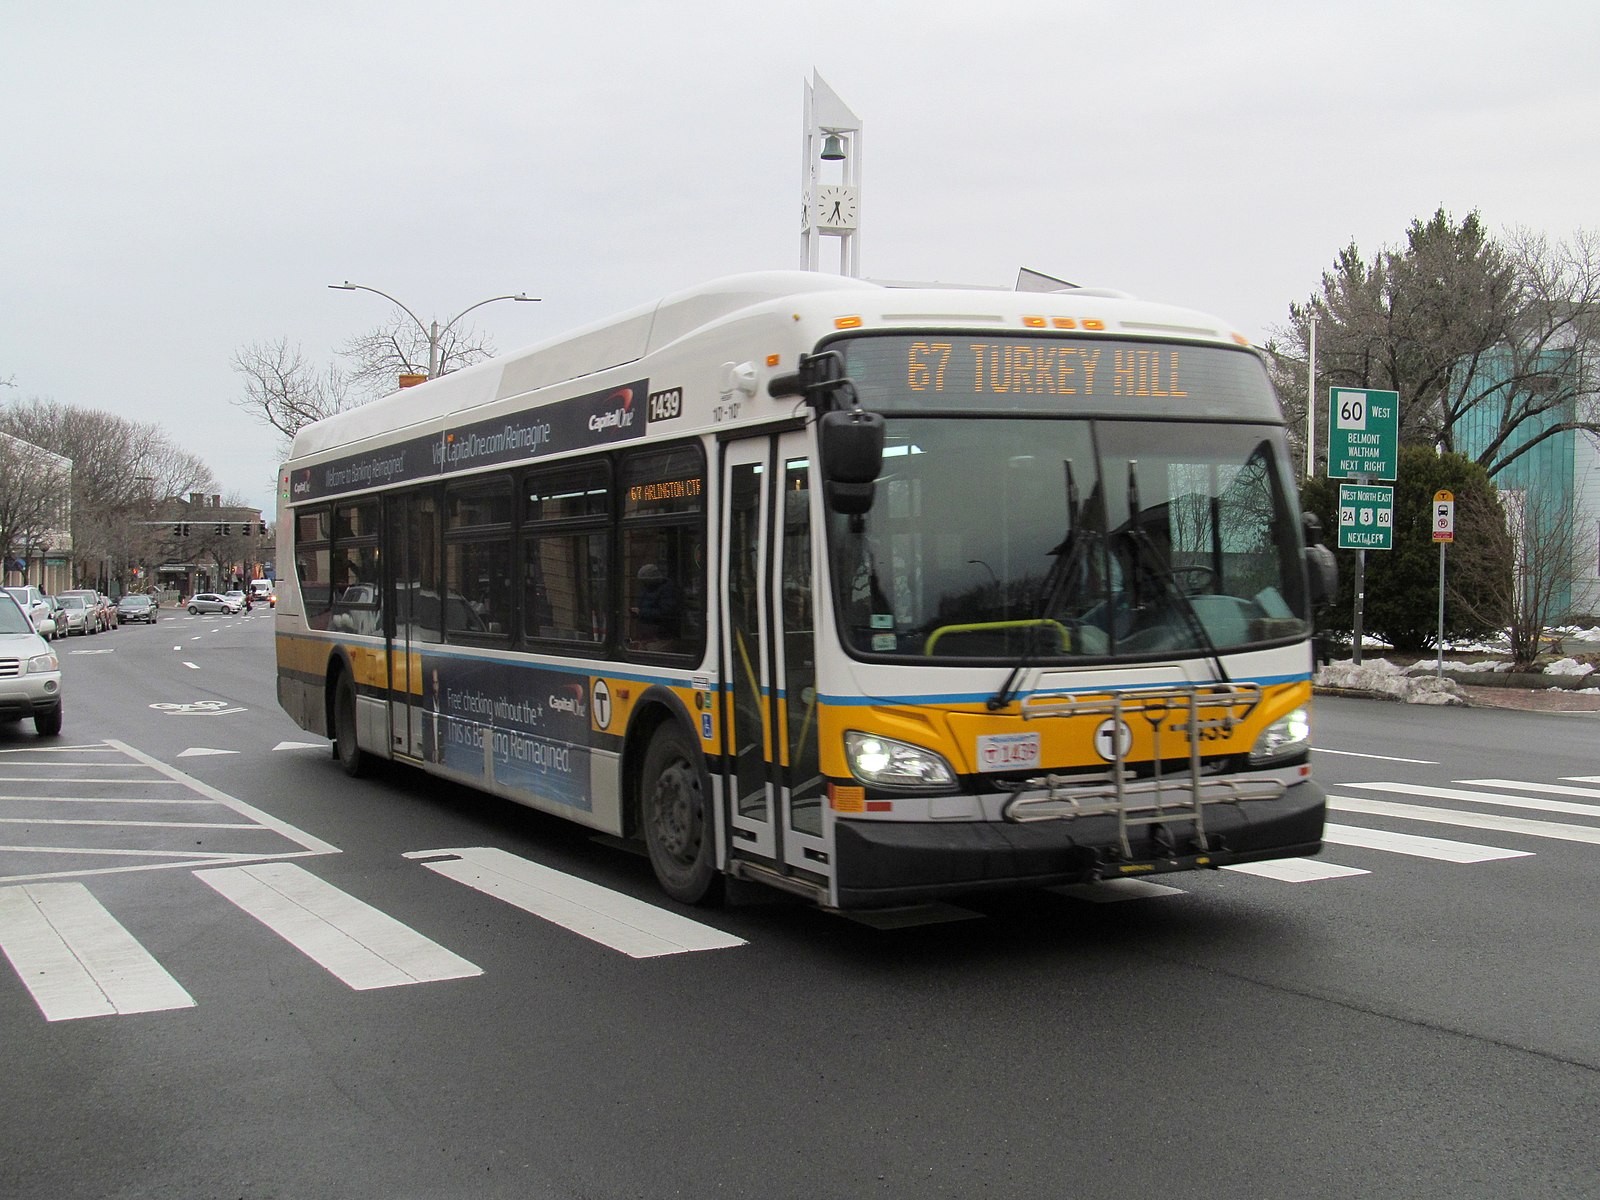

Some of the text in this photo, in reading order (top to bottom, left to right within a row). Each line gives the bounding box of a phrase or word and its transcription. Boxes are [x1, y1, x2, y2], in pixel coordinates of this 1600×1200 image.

[908, 342, 1187, 397] 67 TURKEY HILL
[650, 391, 680, 420] 1439
[1341, 401, 1391, 421] 60 WEST
[1347, 433, 1380, 444] BELMONT
[1348, 446, 1380, 457] WALTHAM
[1340, 460, 1386, 471] NEXT RIGHT
[631, 486, 641, 500] 67
[645, 481, 684, 500] ARLINGTON
[1342, 490, 1392, 502] WEST NORTH EAST
[1343, 511, 1389, 522] 2A 3 60
[1347, 533, 1384, 543] NEXT LEFT
[463, 690, 493, 721] checking
[494, 696, 523, 722] without
[1002, 743, 1037, 762] 1439
